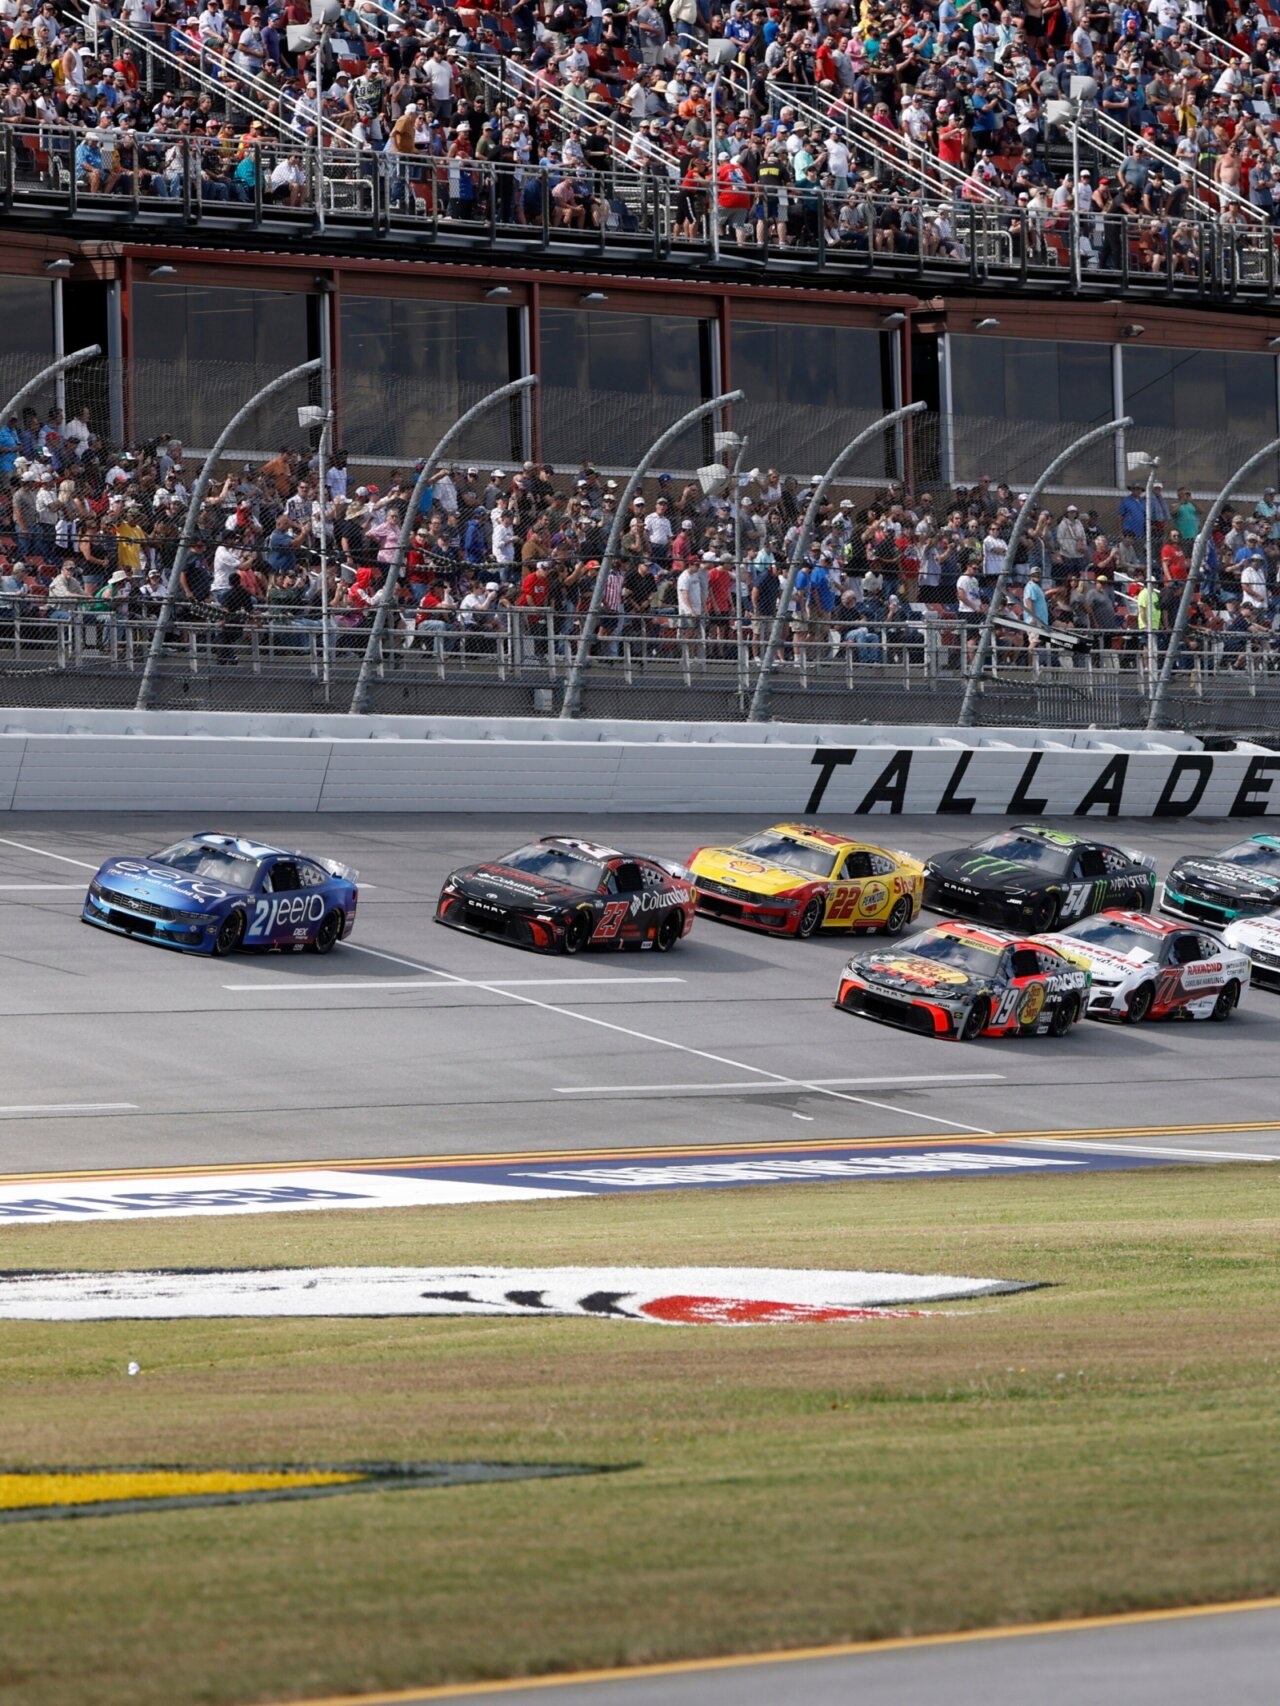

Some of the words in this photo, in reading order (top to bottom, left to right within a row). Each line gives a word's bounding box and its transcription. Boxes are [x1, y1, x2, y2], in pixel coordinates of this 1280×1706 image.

[115, 861, 227, 898] eero
[944, 882, 980, 897] CAMRY
[468, 900, 507, 915] CAMRY
[641, 885, 690, 912] Columbia
[827, 886, 861, 919] 22
[1061, 883, 1093, 918] 54
[248, 899, 278, 936] 21
[276, 894, 325, 925] eero
[592, 901, 629, 938] 23
[293, 927, 308, 936] DEX
[1045, 971, 1086, 993] TRACKER
[1187, 962, 1223, 976] RAYMOND
[868, 985, 907, 999] CAMRY
[991, 988, 1019, 1024] 19
